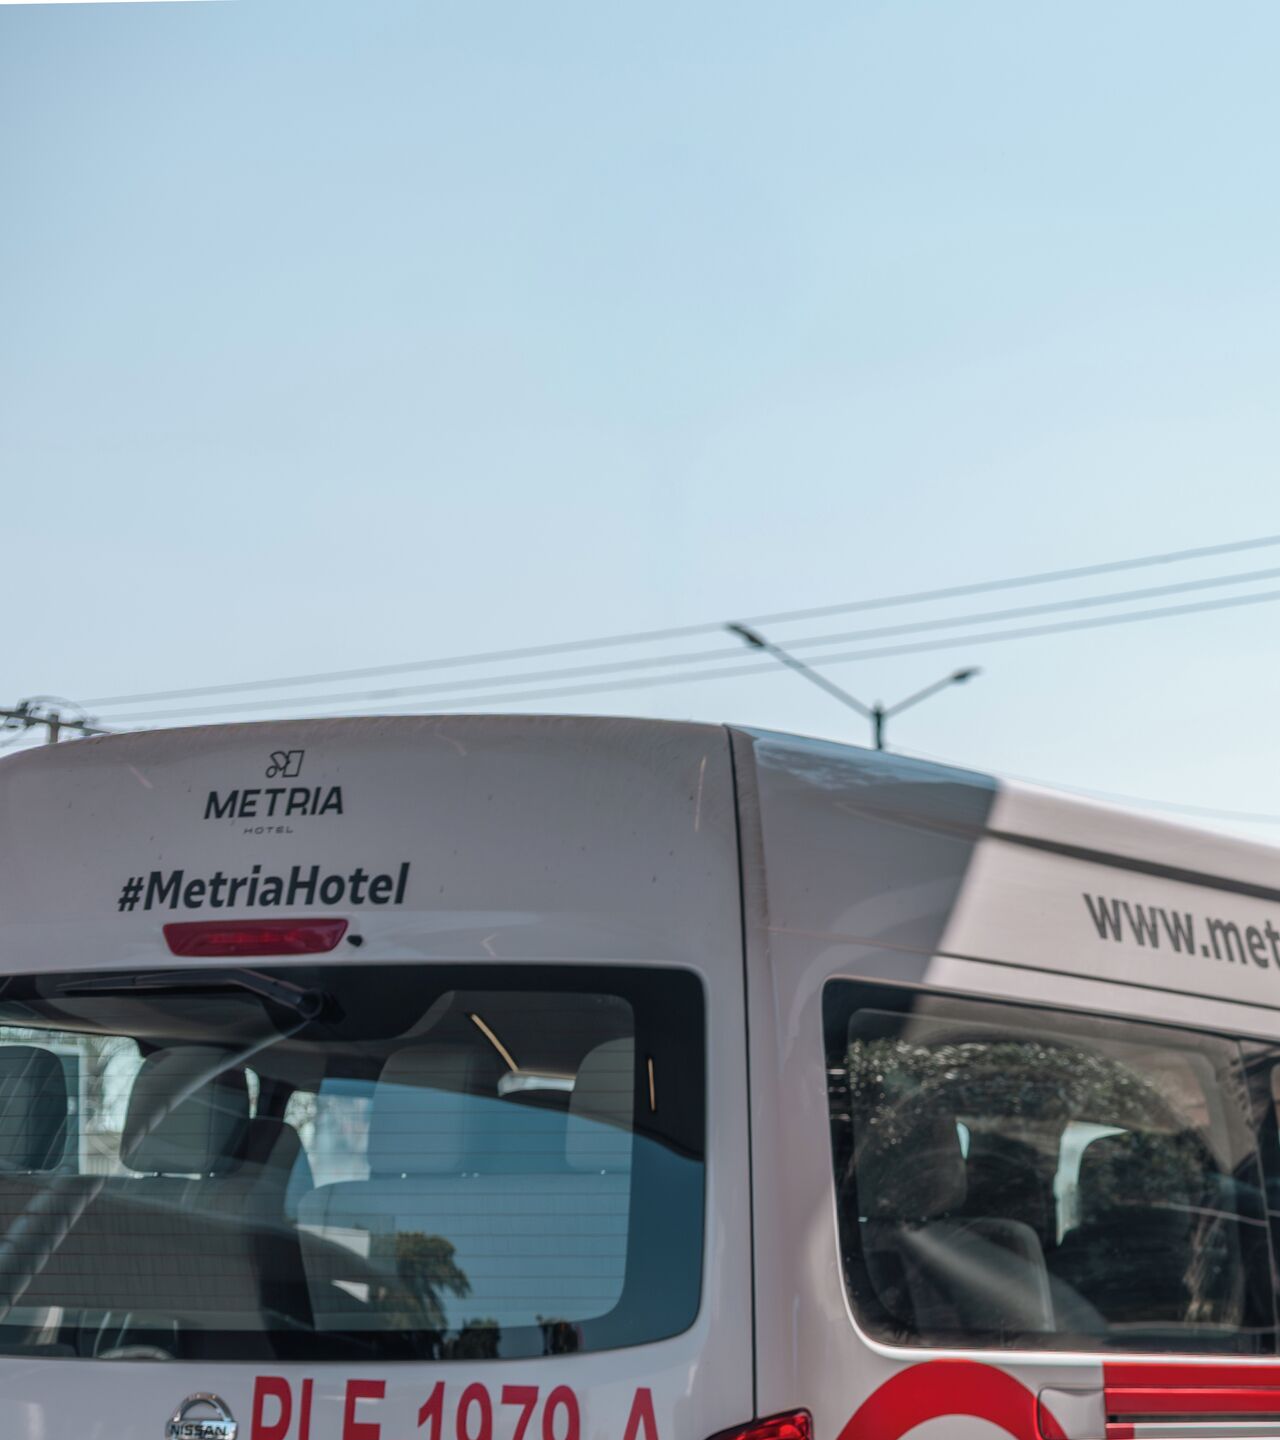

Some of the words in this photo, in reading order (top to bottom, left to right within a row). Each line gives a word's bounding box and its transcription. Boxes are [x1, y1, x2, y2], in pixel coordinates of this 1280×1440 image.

[203, 785, 344, 820] METRIA
[242, 825, 294, 836] HOTEL
[117, 862, 410, 912] #MetriaHotel
[170, 1424, 227, 1437] NISSAN
